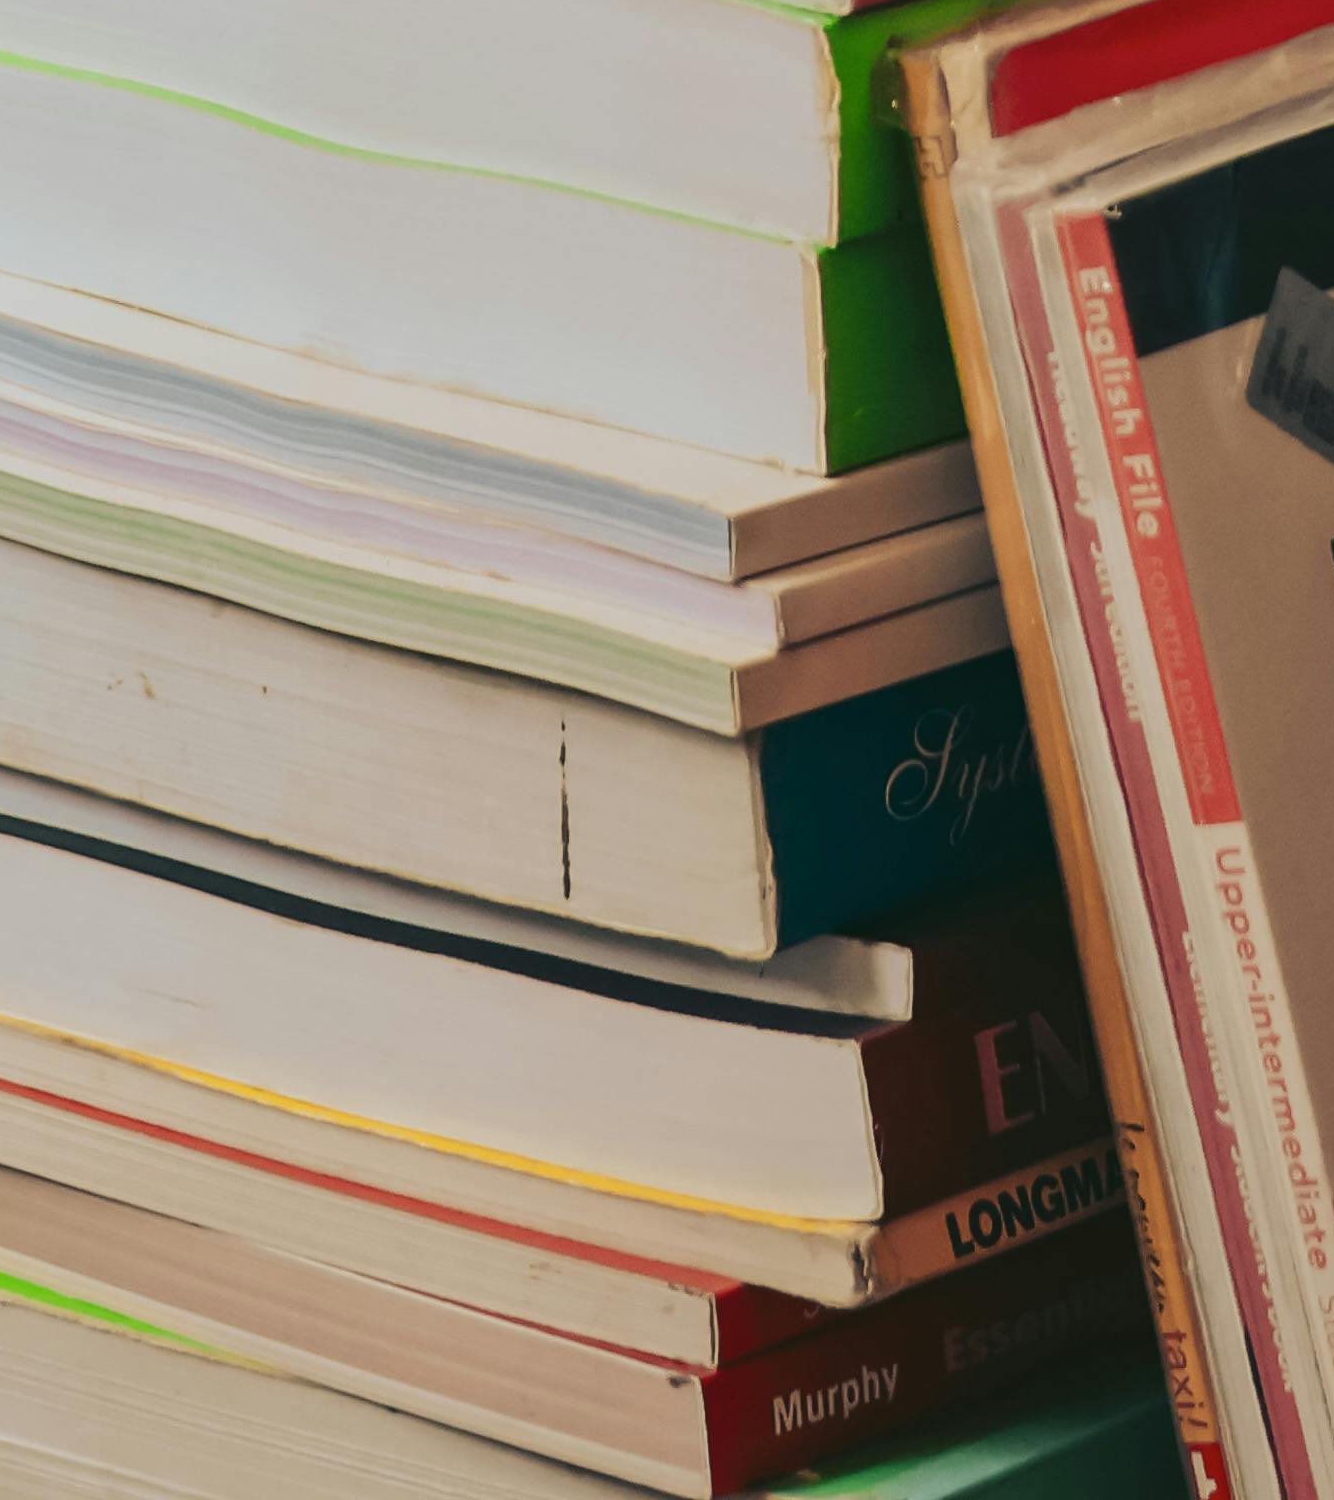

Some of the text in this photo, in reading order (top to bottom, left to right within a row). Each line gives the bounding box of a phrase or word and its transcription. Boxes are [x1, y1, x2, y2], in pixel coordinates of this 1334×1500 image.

[1076, 265, 1142, 439] English
[1121, 454, 1160, 539] File
[1215, 846, 1328, 1272] Upper-intermediate
[770, 1360, 900, 1438] Murphy
